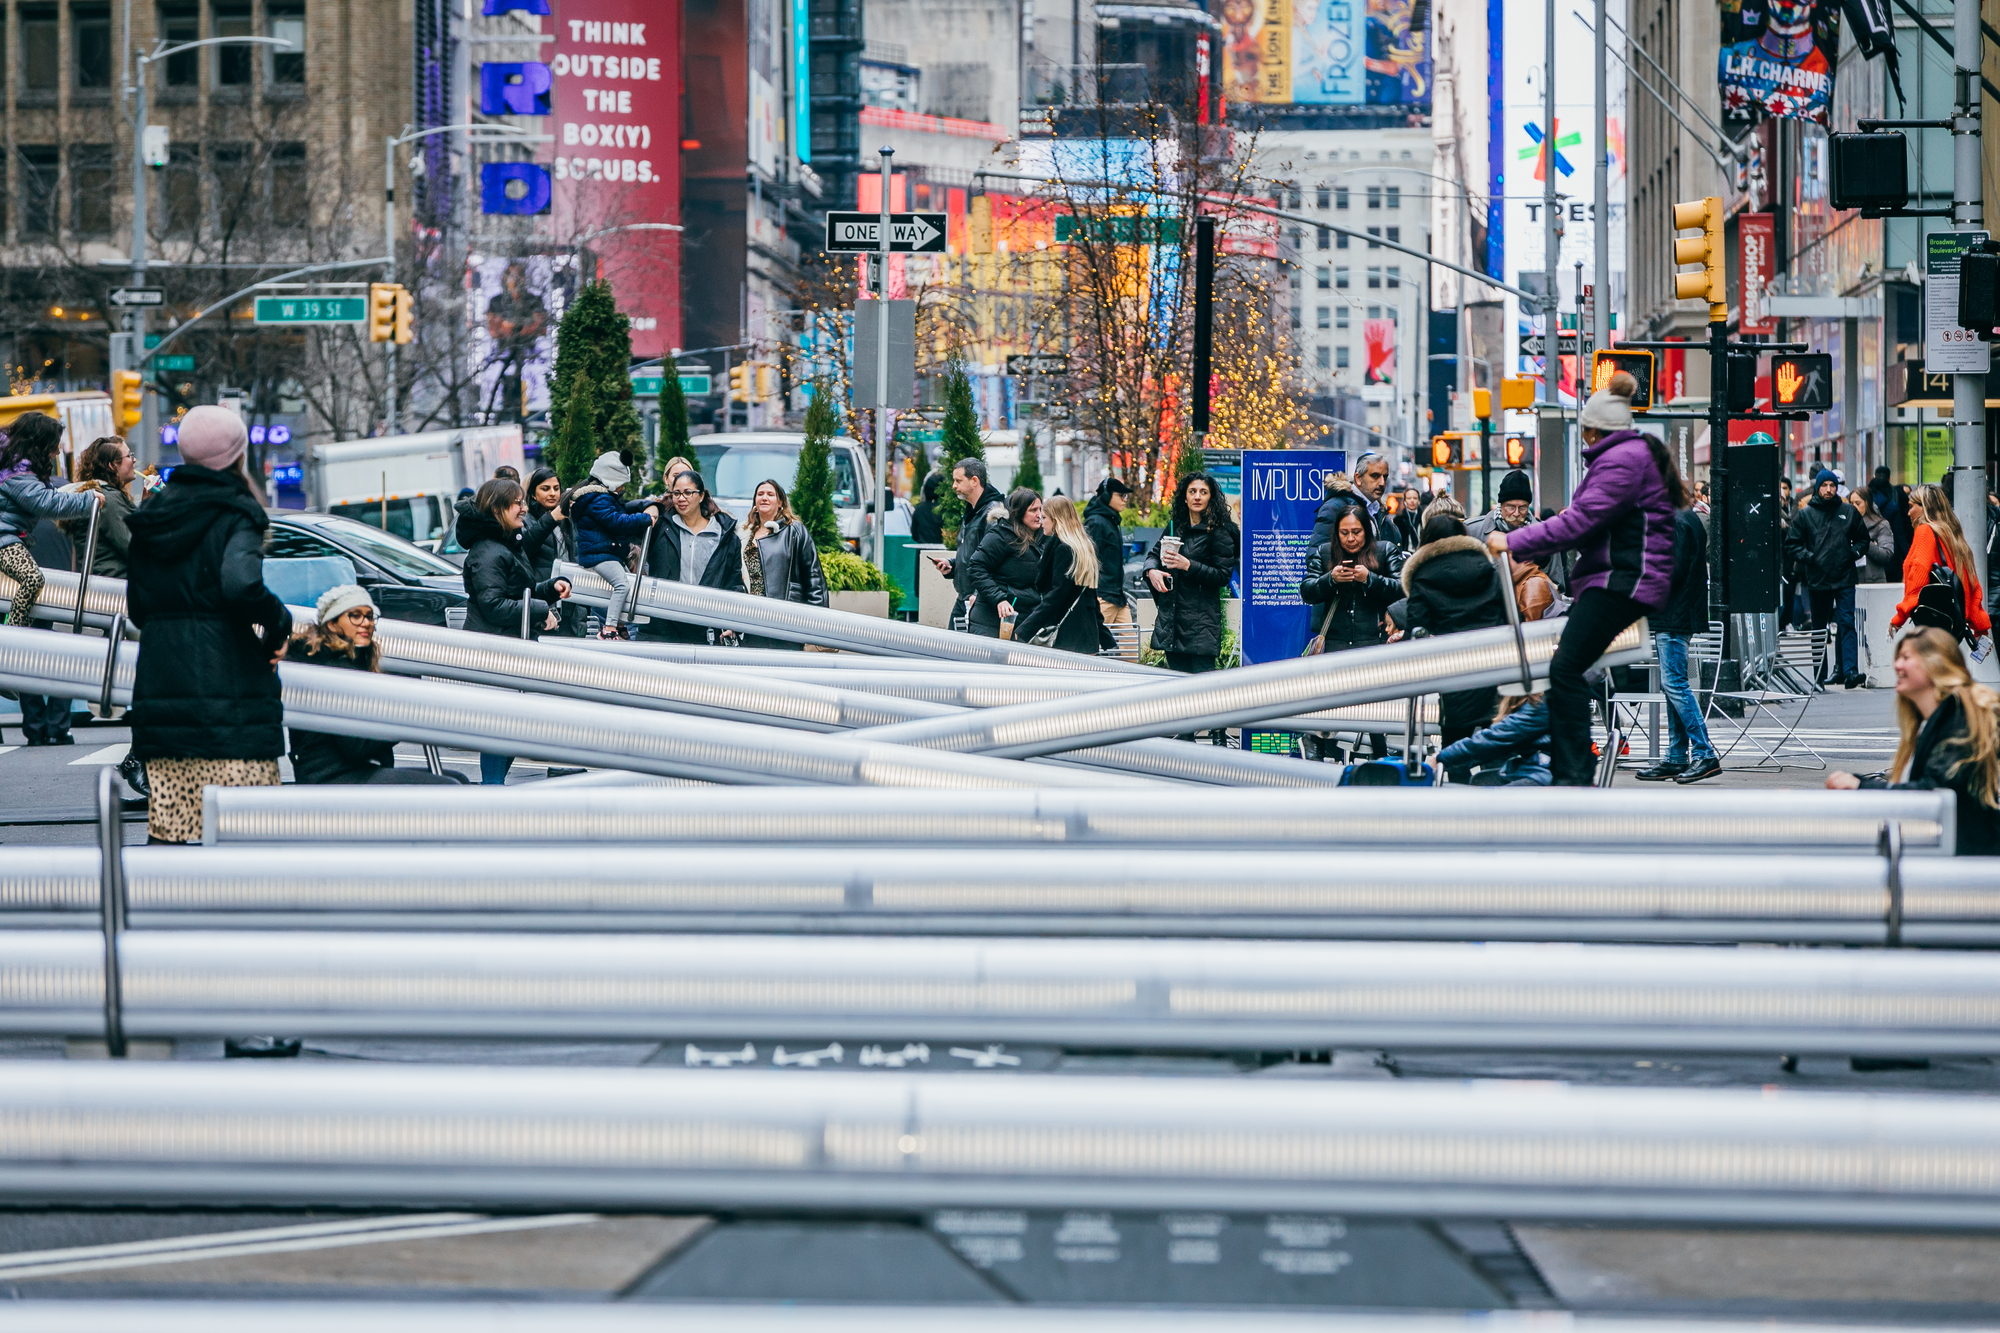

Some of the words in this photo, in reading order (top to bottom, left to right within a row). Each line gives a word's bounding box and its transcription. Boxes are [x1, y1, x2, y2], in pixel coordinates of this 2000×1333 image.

[568, 20, 646, 46] THINK
[555, 53, 661, 81] OUTSIDE
[583, 89, 632, 114] THE
[563, 123, 651, 149] BOX(Y)
[555, 157, 660, 183] SCRUBS.
[844, 225, 878, 240] ONE
[894, 226, 928, 241] WAY
[282, 302, 296, 318] W
[302, 302, 320, 318] 39
[326, 302, 341, 318] St
[1585, 342, 1592, 352] 6
[1919, 368, 1949, 392] 14
[1679, 426, 1689, 481] Newsstand
